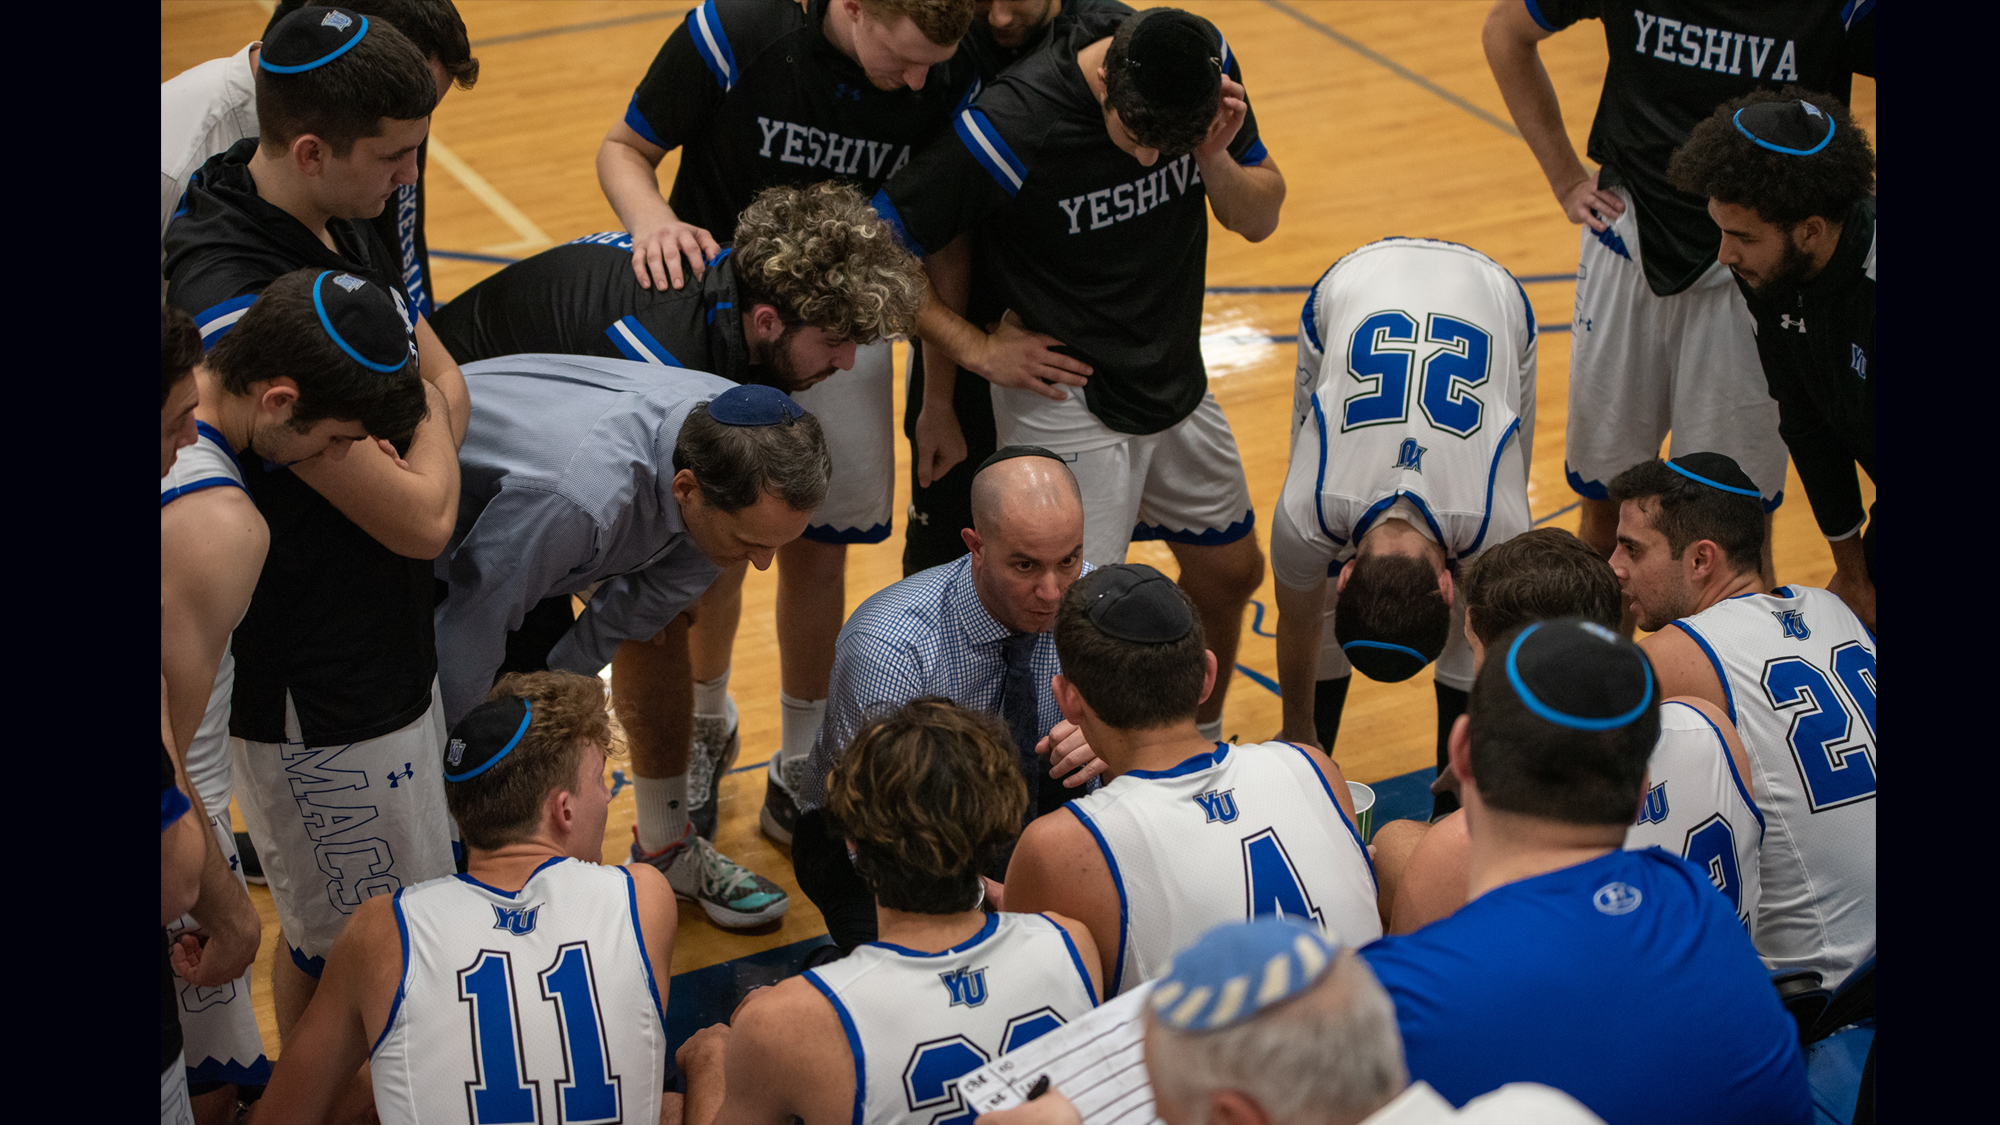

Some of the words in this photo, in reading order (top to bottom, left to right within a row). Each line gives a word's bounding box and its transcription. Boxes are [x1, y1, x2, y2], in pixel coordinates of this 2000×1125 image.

[1633, 9, 1798, 81] YESHIVA
[1341, 309, 1493, 440] 25
[1392, 437, 1428, 475] YU
[1771, 609, 1811, 641] YU
[1192, 789, 1240, 825] YU
[490, 902, 542, 936] YU
[938, 965, 989, 1009] YU
[456, 940, 623, 1125] 11
